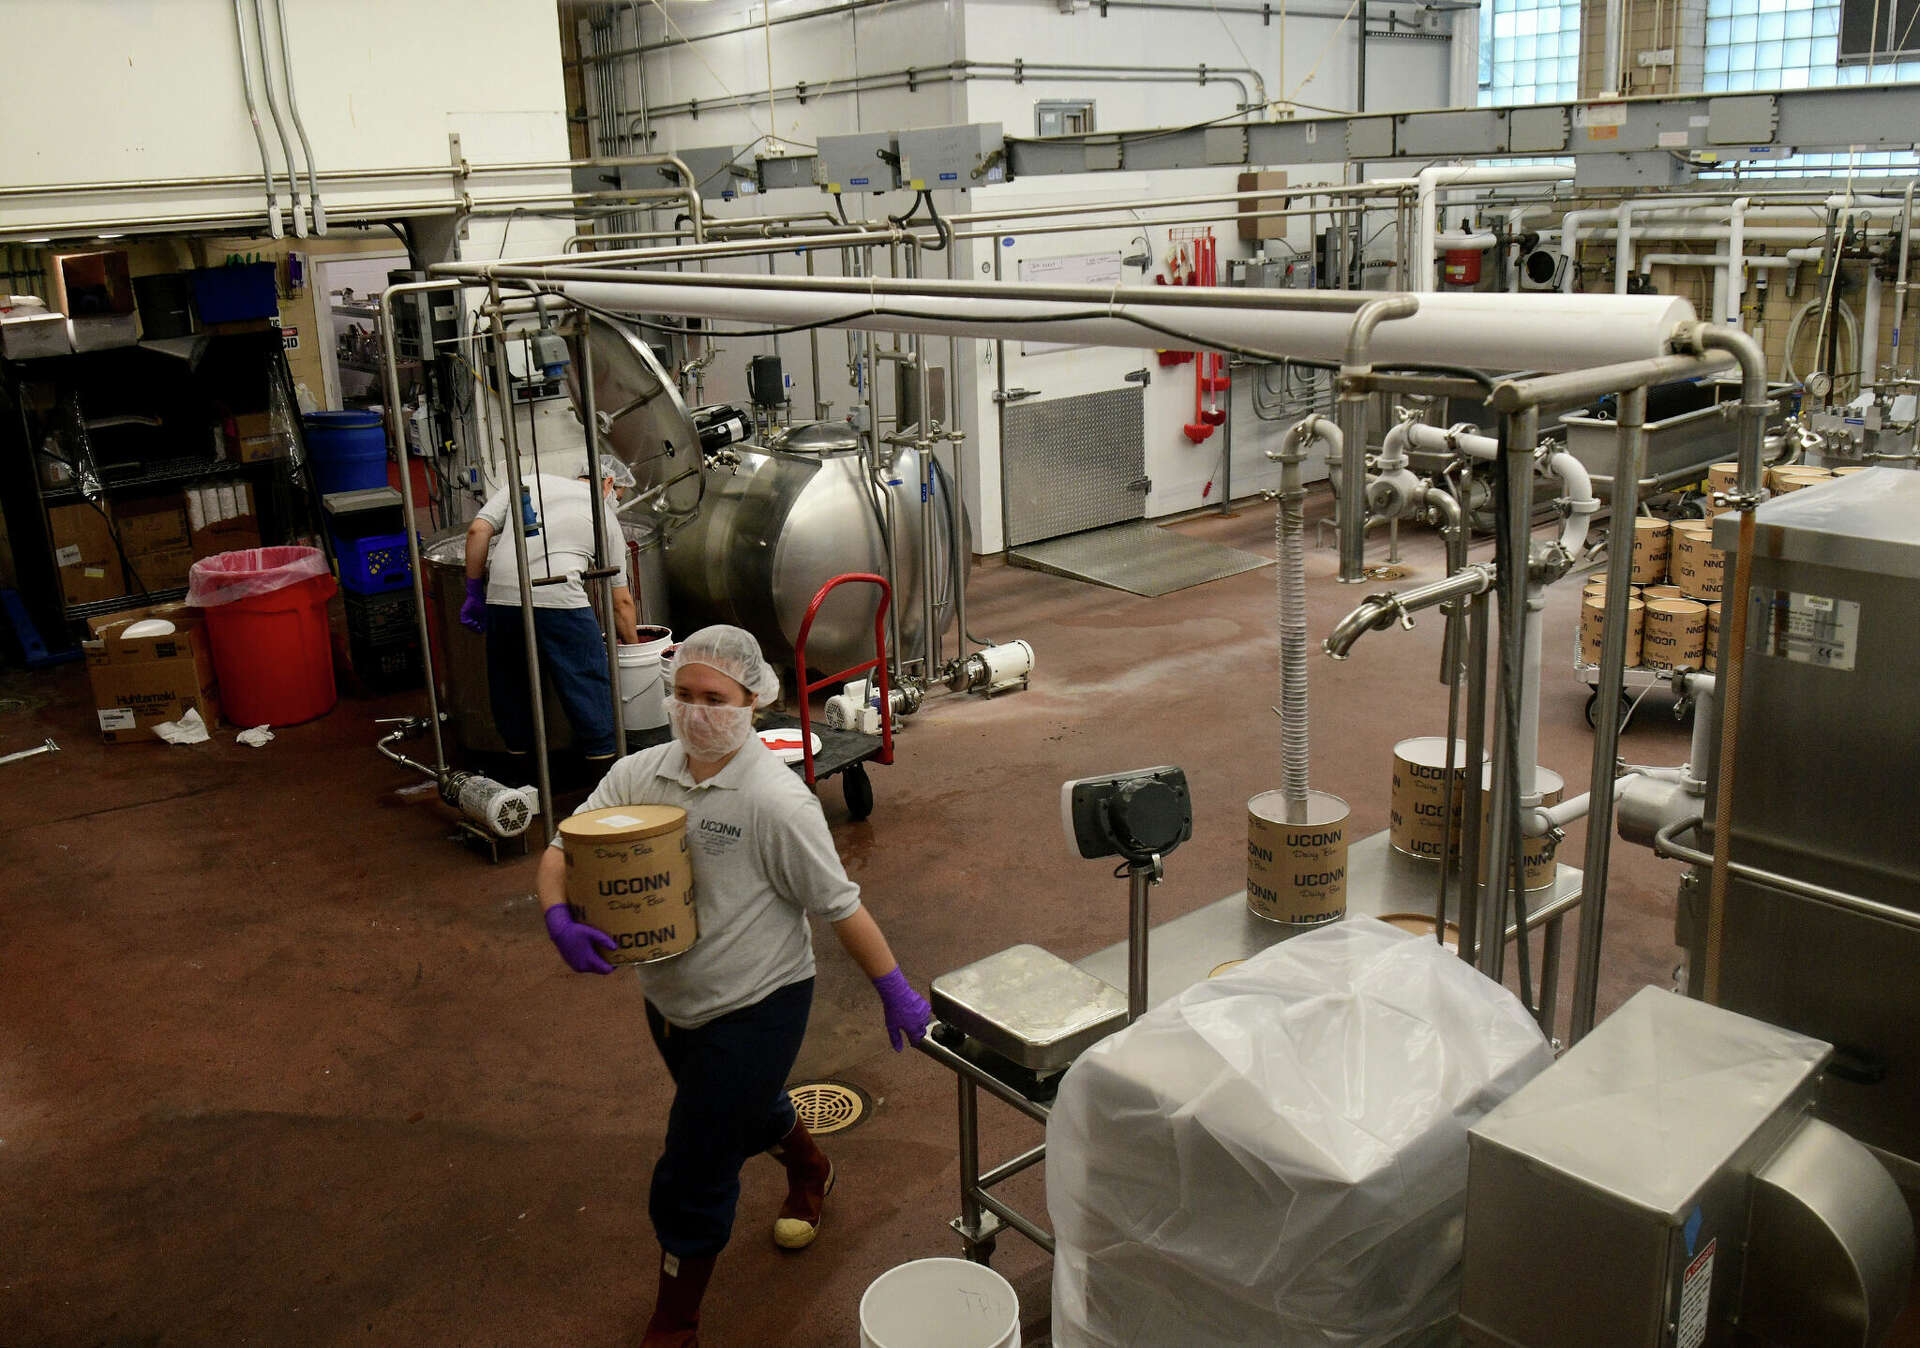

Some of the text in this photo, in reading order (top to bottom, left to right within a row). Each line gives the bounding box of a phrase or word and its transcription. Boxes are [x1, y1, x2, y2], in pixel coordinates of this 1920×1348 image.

[281, 337, 298, 348] CID
[1409, 764, 1467, 781] UCON
[700, 818, 742, 838] UCONN
[1286, 829, 1342, 847] UCONN
[594, 847, 629, 862] Dairy
[598, 871, 671, 897] UCONN
[1294, 866, 1345, 887] UCONN
[607, 899, 642, 914] Dairy
